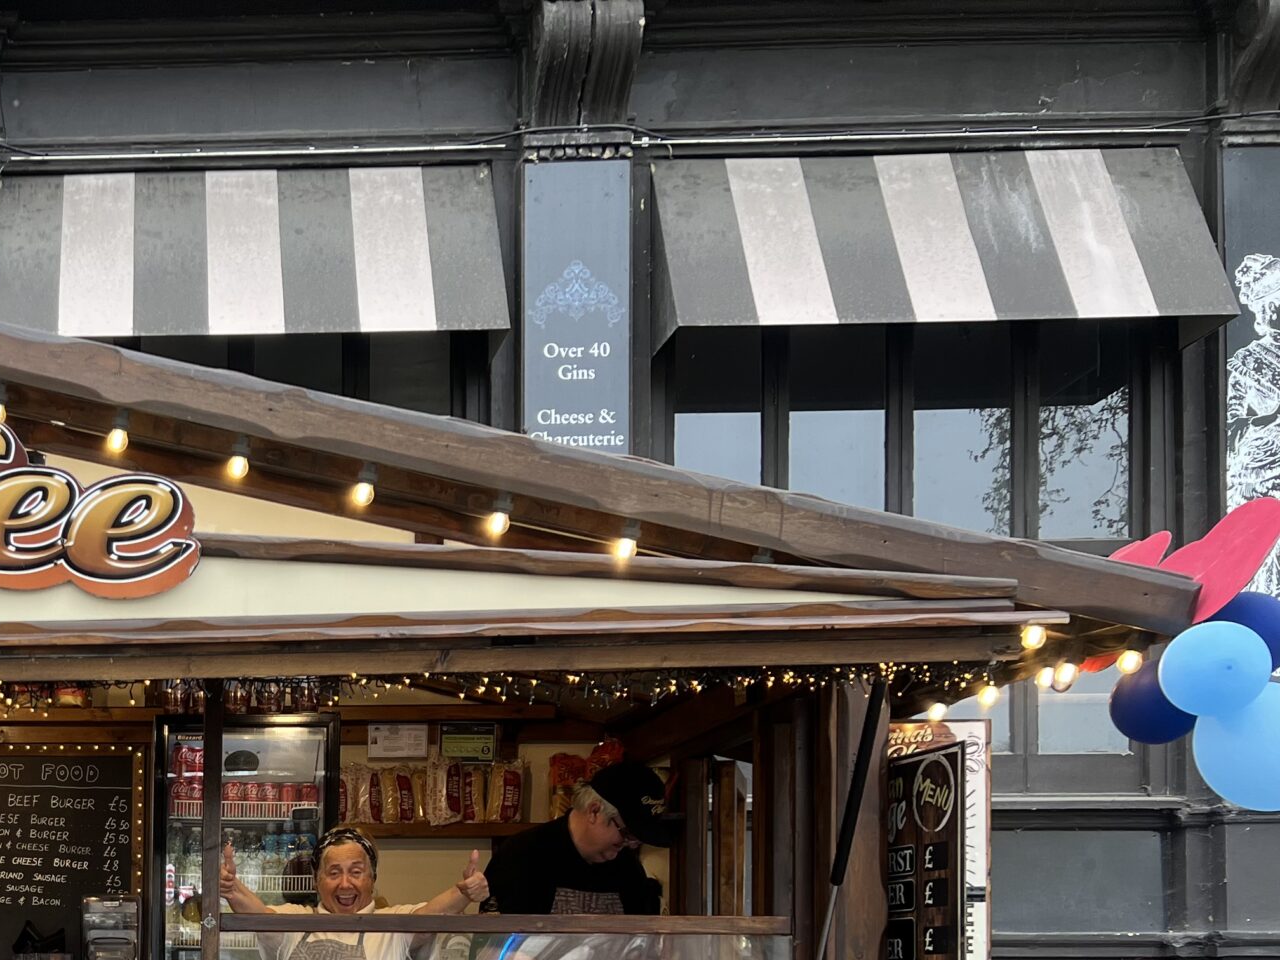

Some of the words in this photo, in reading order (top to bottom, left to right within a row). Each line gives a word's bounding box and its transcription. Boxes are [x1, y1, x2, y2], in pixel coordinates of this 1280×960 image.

[543, 343, 584, 358] Over
[589, 342, 610, 357] 40
[558, 365, 595, 380] Gins
[537, 409, 593, 425] Cheese
[599, 409, 616, 424] &
[41, 764, 100, 783] FOOD
[917, 777, 952, 811] MENU
[8, 794, 40, 807] BEEF
[51, 795, 95, 810] BURGER
[108, 795, 128, 812] £5
[30, 814, 65, 827] BURGER
[30, 829, 70, 841] BURGER
[16, 842, 50, 851] CHEESE
[59, 844, 91, 855] BURGER
[103, 846, 117, 857] £6
[925, 846, 933, 868] £
[12, 857, 43, 866] CHEESE
[53, 858, 88, 870] BURGER
[103, 860, 119, 871] £8
[33, 873, 67, 883] SAUSAGE
[106, 875, 121, 887] £5
[6, 884, 44, 894] SAUSAGE
[925, 882, 934, 904] £
[32, 897, 60, 906] BACON
[925, 929, 934, 950] £
